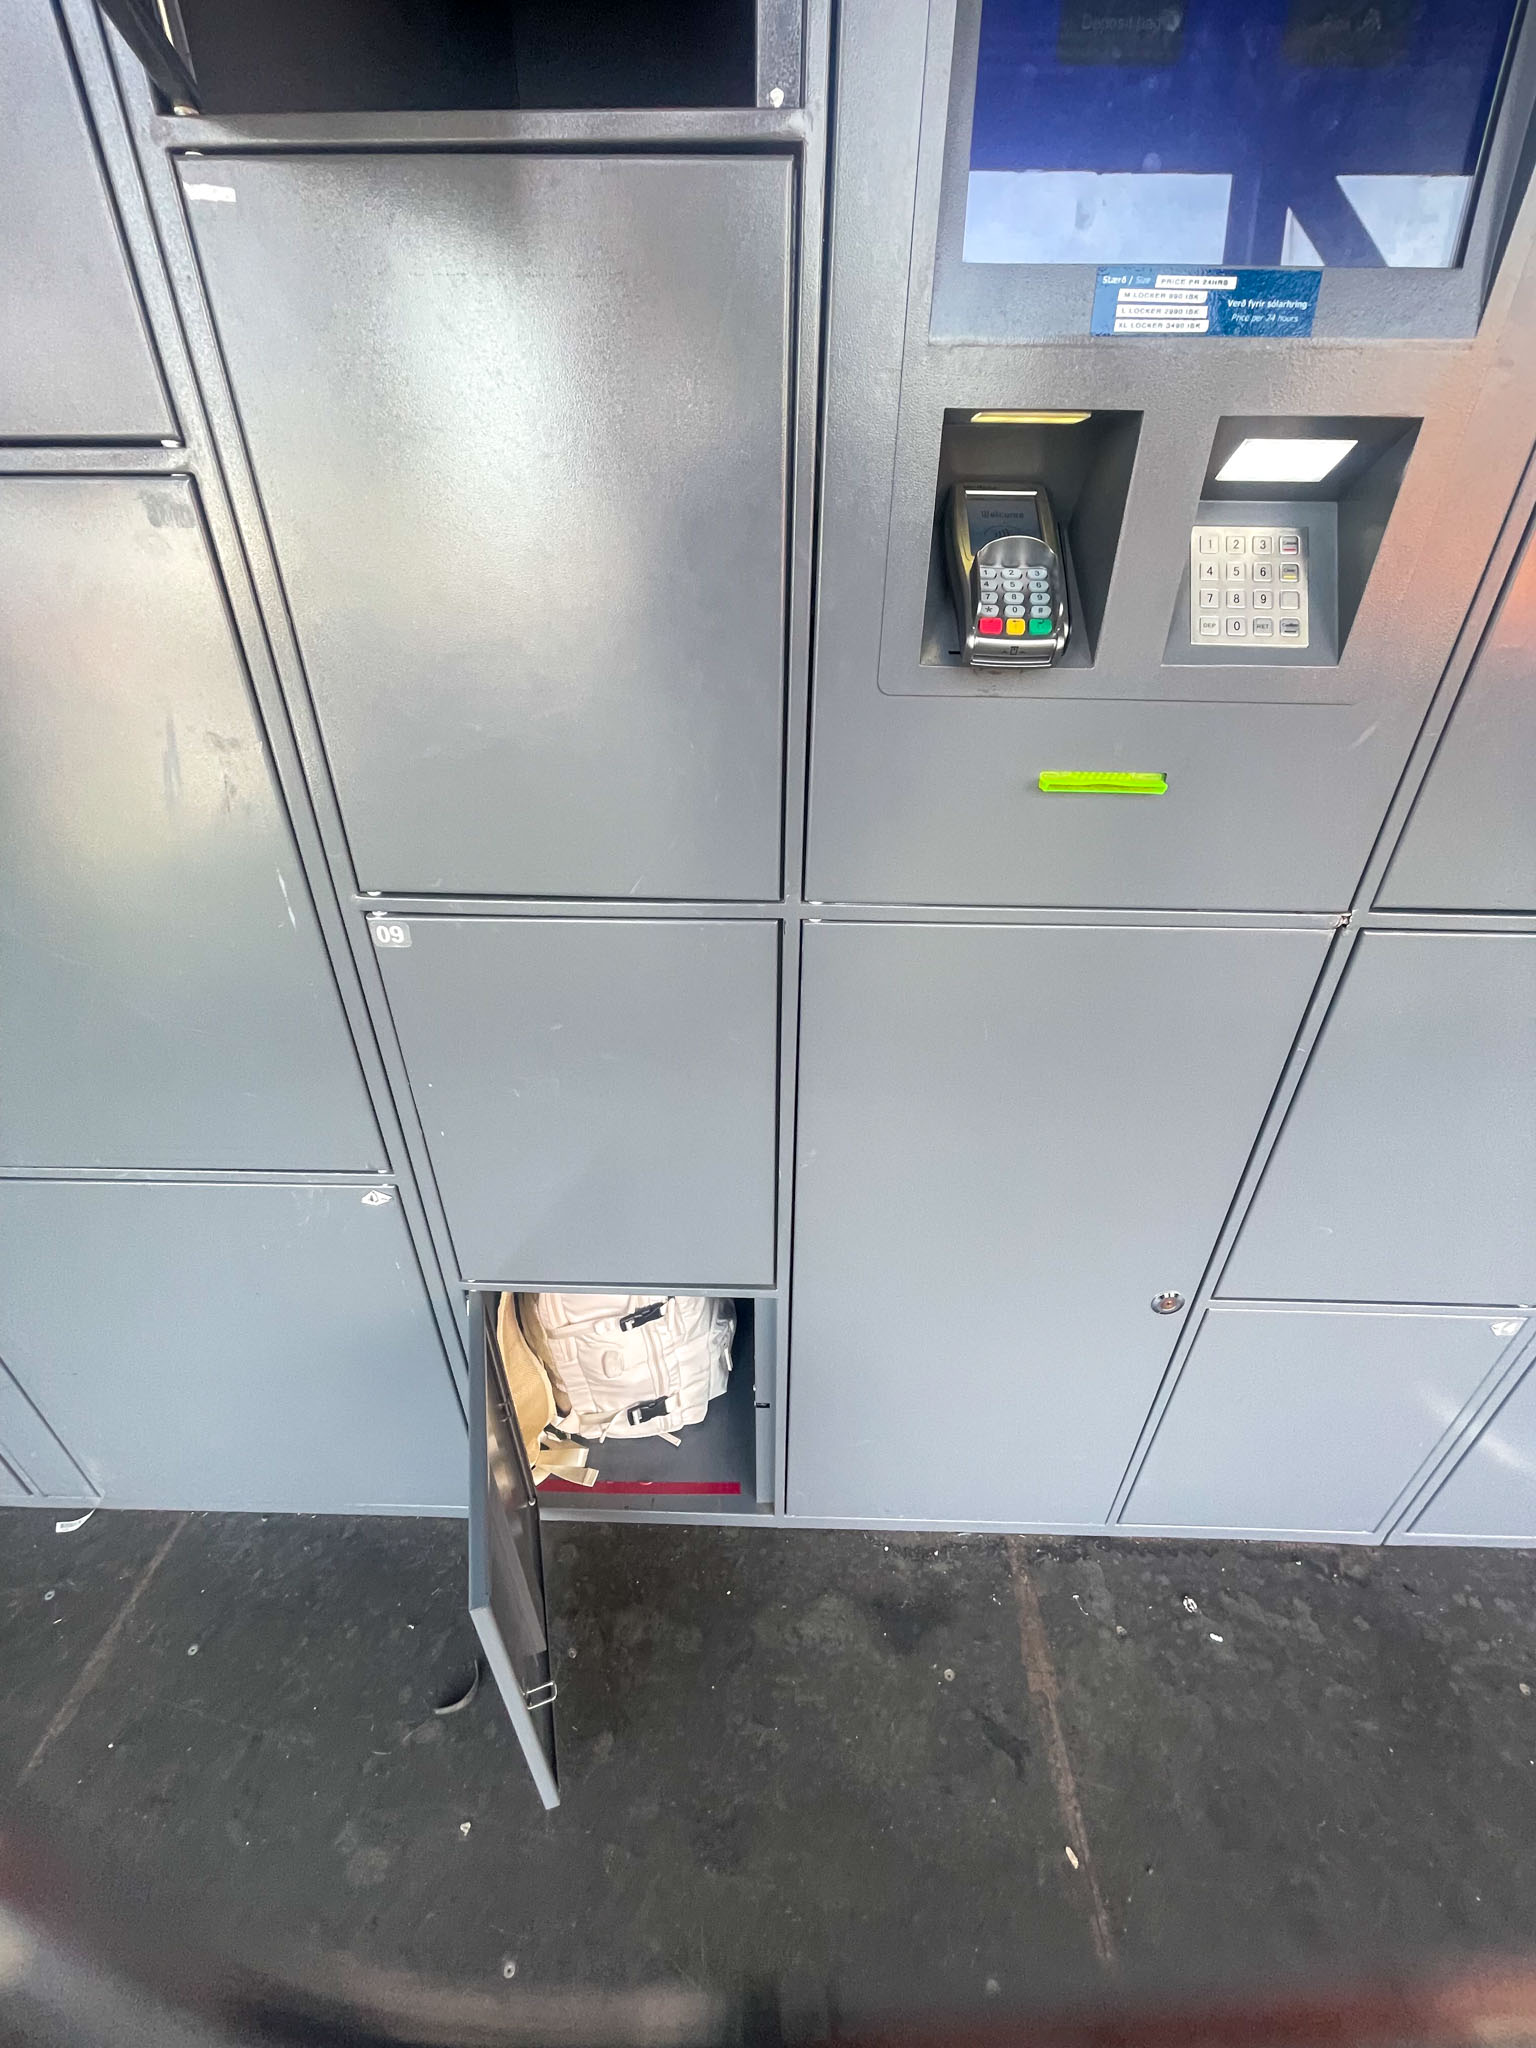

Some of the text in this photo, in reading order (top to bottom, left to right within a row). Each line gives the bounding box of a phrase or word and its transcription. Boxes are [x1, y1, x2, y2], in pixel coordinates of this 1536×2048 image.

[1161, 278, 1185, 286] PRICE
[1227, 298, 1308, 311] Verð fyrir sólarhring
[1231, 313, 1299, 326] Price per 24 hours
[981, 510, 1025, 519] Welcome
[1232, 540, 1240, 550] 2
[1259, 540, 1267, 550] 3
[1206, 566, 1267, 577] 4 5 6
[1207, 593, 1267, 604] 7 8 9
[1233, 620, 1241, 632] 0
[376, 925, 405, 944] 09
